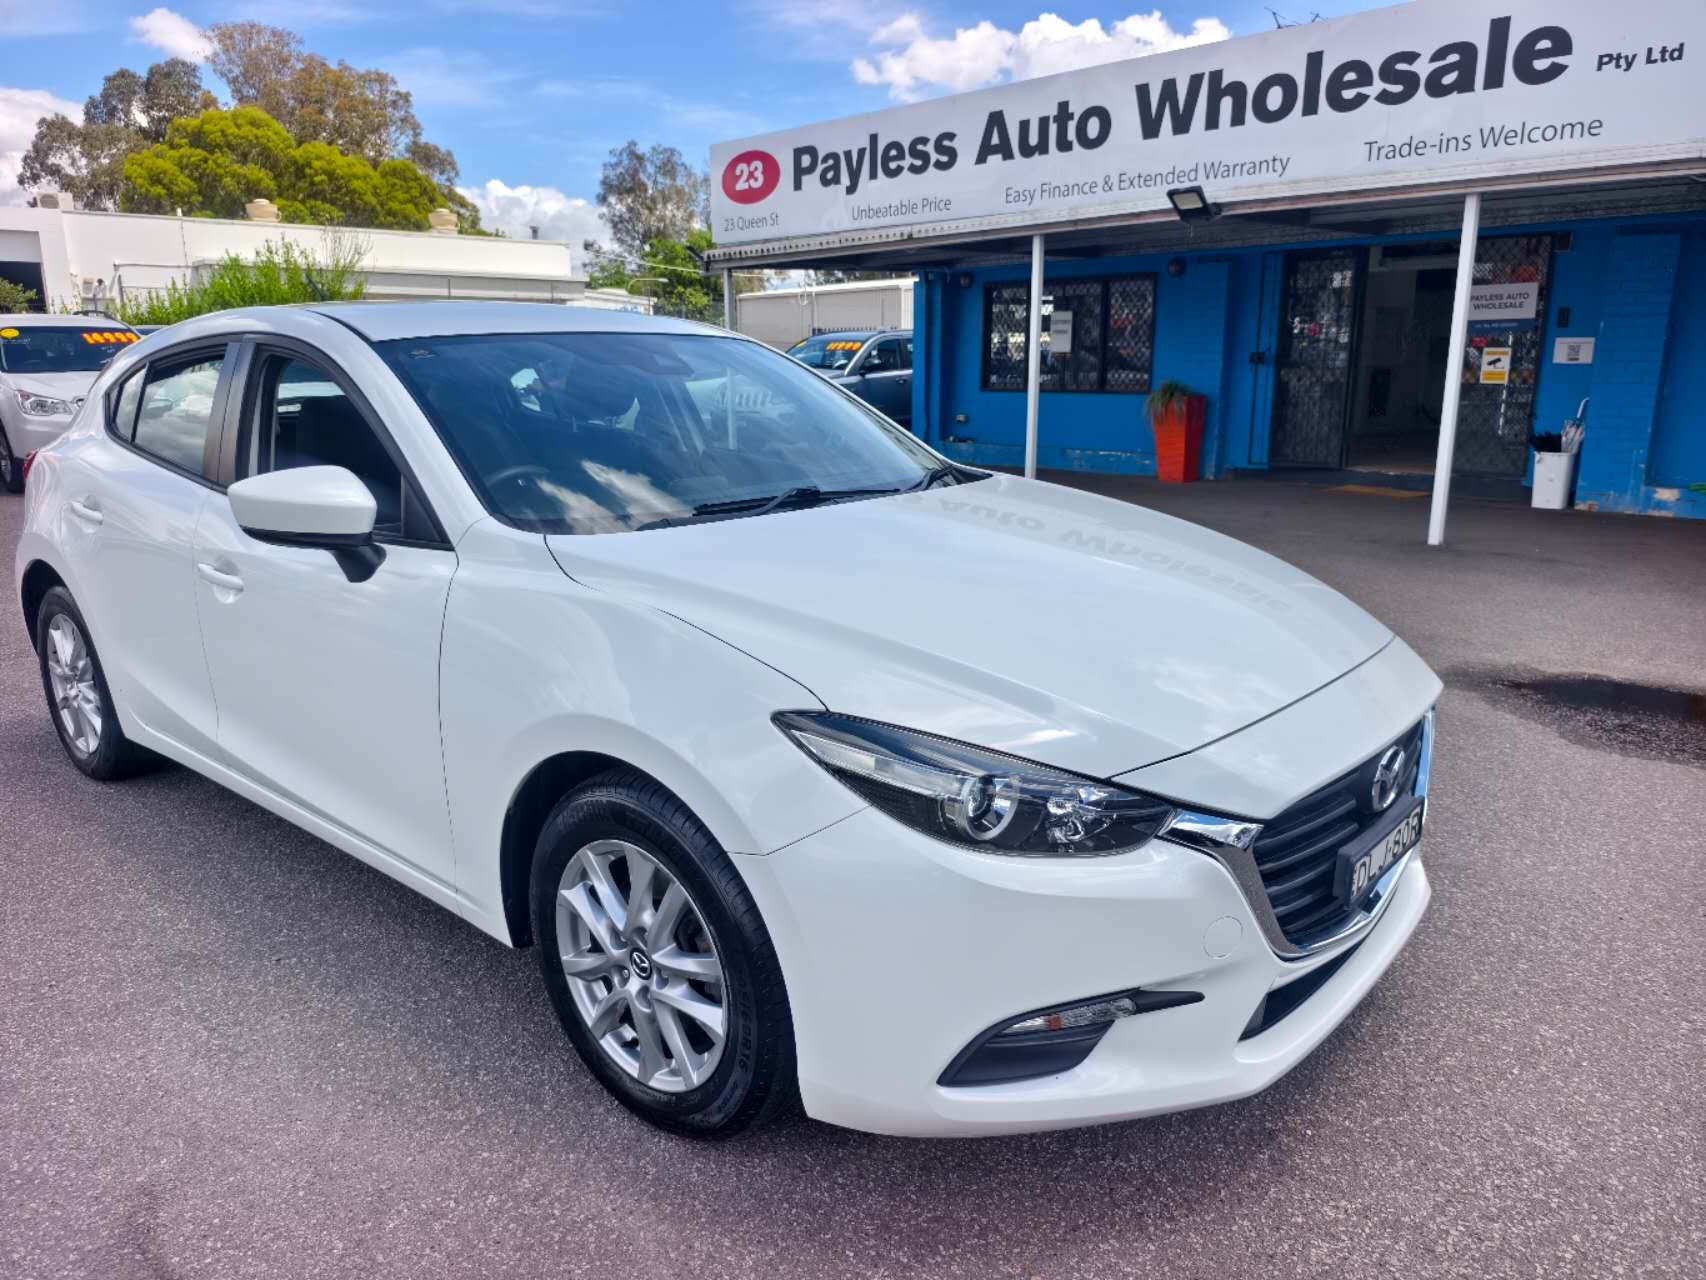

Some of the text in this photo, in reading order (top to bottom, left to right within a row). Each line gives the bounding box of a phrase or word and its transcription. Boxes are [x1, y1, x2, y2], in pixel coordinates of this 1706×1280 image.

[793, 15, 1685, 195] Payless Auto Wholesale Pty Ltd
[1363, 117, 1604, 163] Trade-ins Welcome
[735, 160, 764, 191] 23
[1005, 155, 1292, 206] Easy Finance & Extended Warranty
[723, 211, 779, 232] 23 Queen St
[851, 197, 952, 222] Unbeatable Price
[1471, 292, 1530, 302] PAYLESS AUTO
[1473, 301, 1525, 310] WHOLESALE
